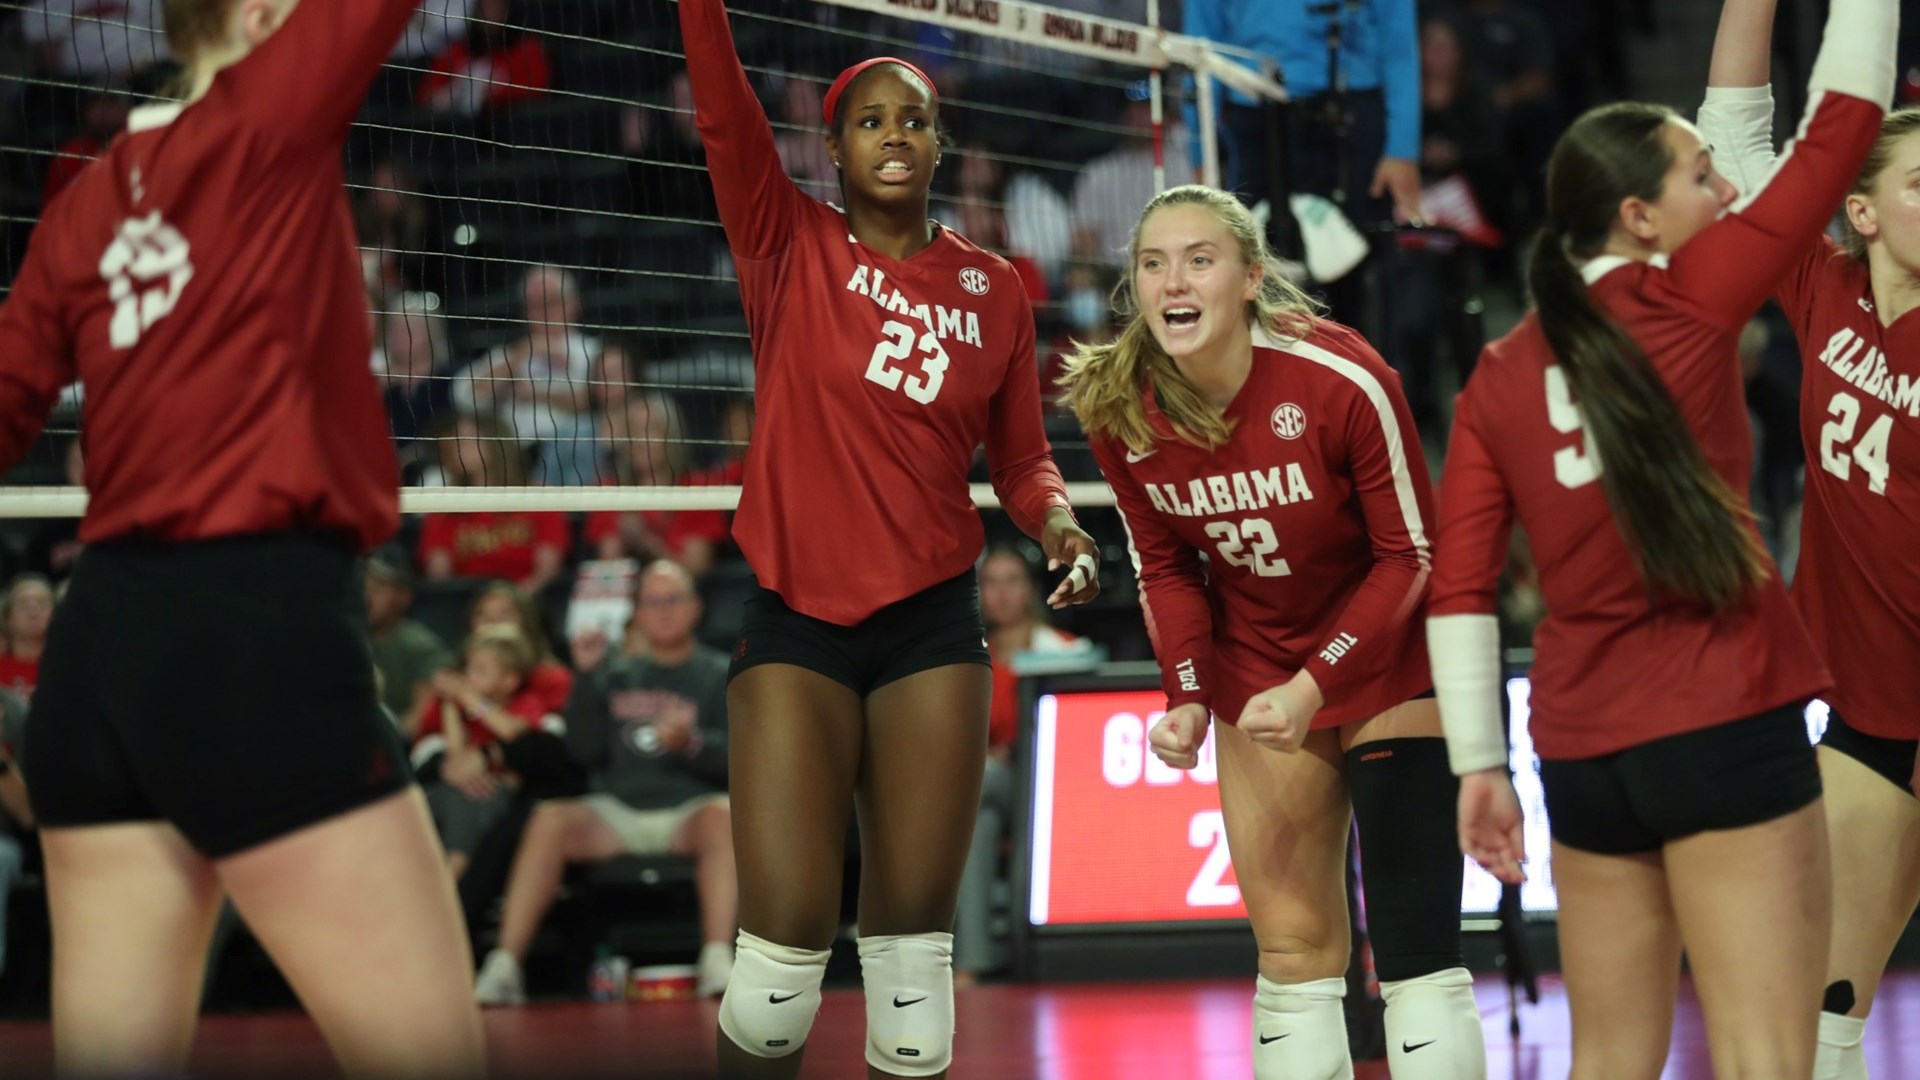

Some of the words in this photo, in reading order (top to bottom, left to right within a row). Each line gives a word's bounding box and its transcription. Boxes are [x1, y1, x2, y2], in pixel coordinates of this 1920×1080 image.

[847, 264, 982, 349] ALAAMA
[961, 268, 988, 294] SEC
[864, 320, 950, 405] 23
[1273, 405, 1304, 438] SEC
[1820, 392, 1894, 496] 24
[1145, 462, 1313, 517] ALABAMA
[1204, 518, 1292, 577] 22
[1175, 658, 1201, 691] ROLL
[1319, 631, 1358, 665] TIDE
[1186, 809, 1242, 907] 2
